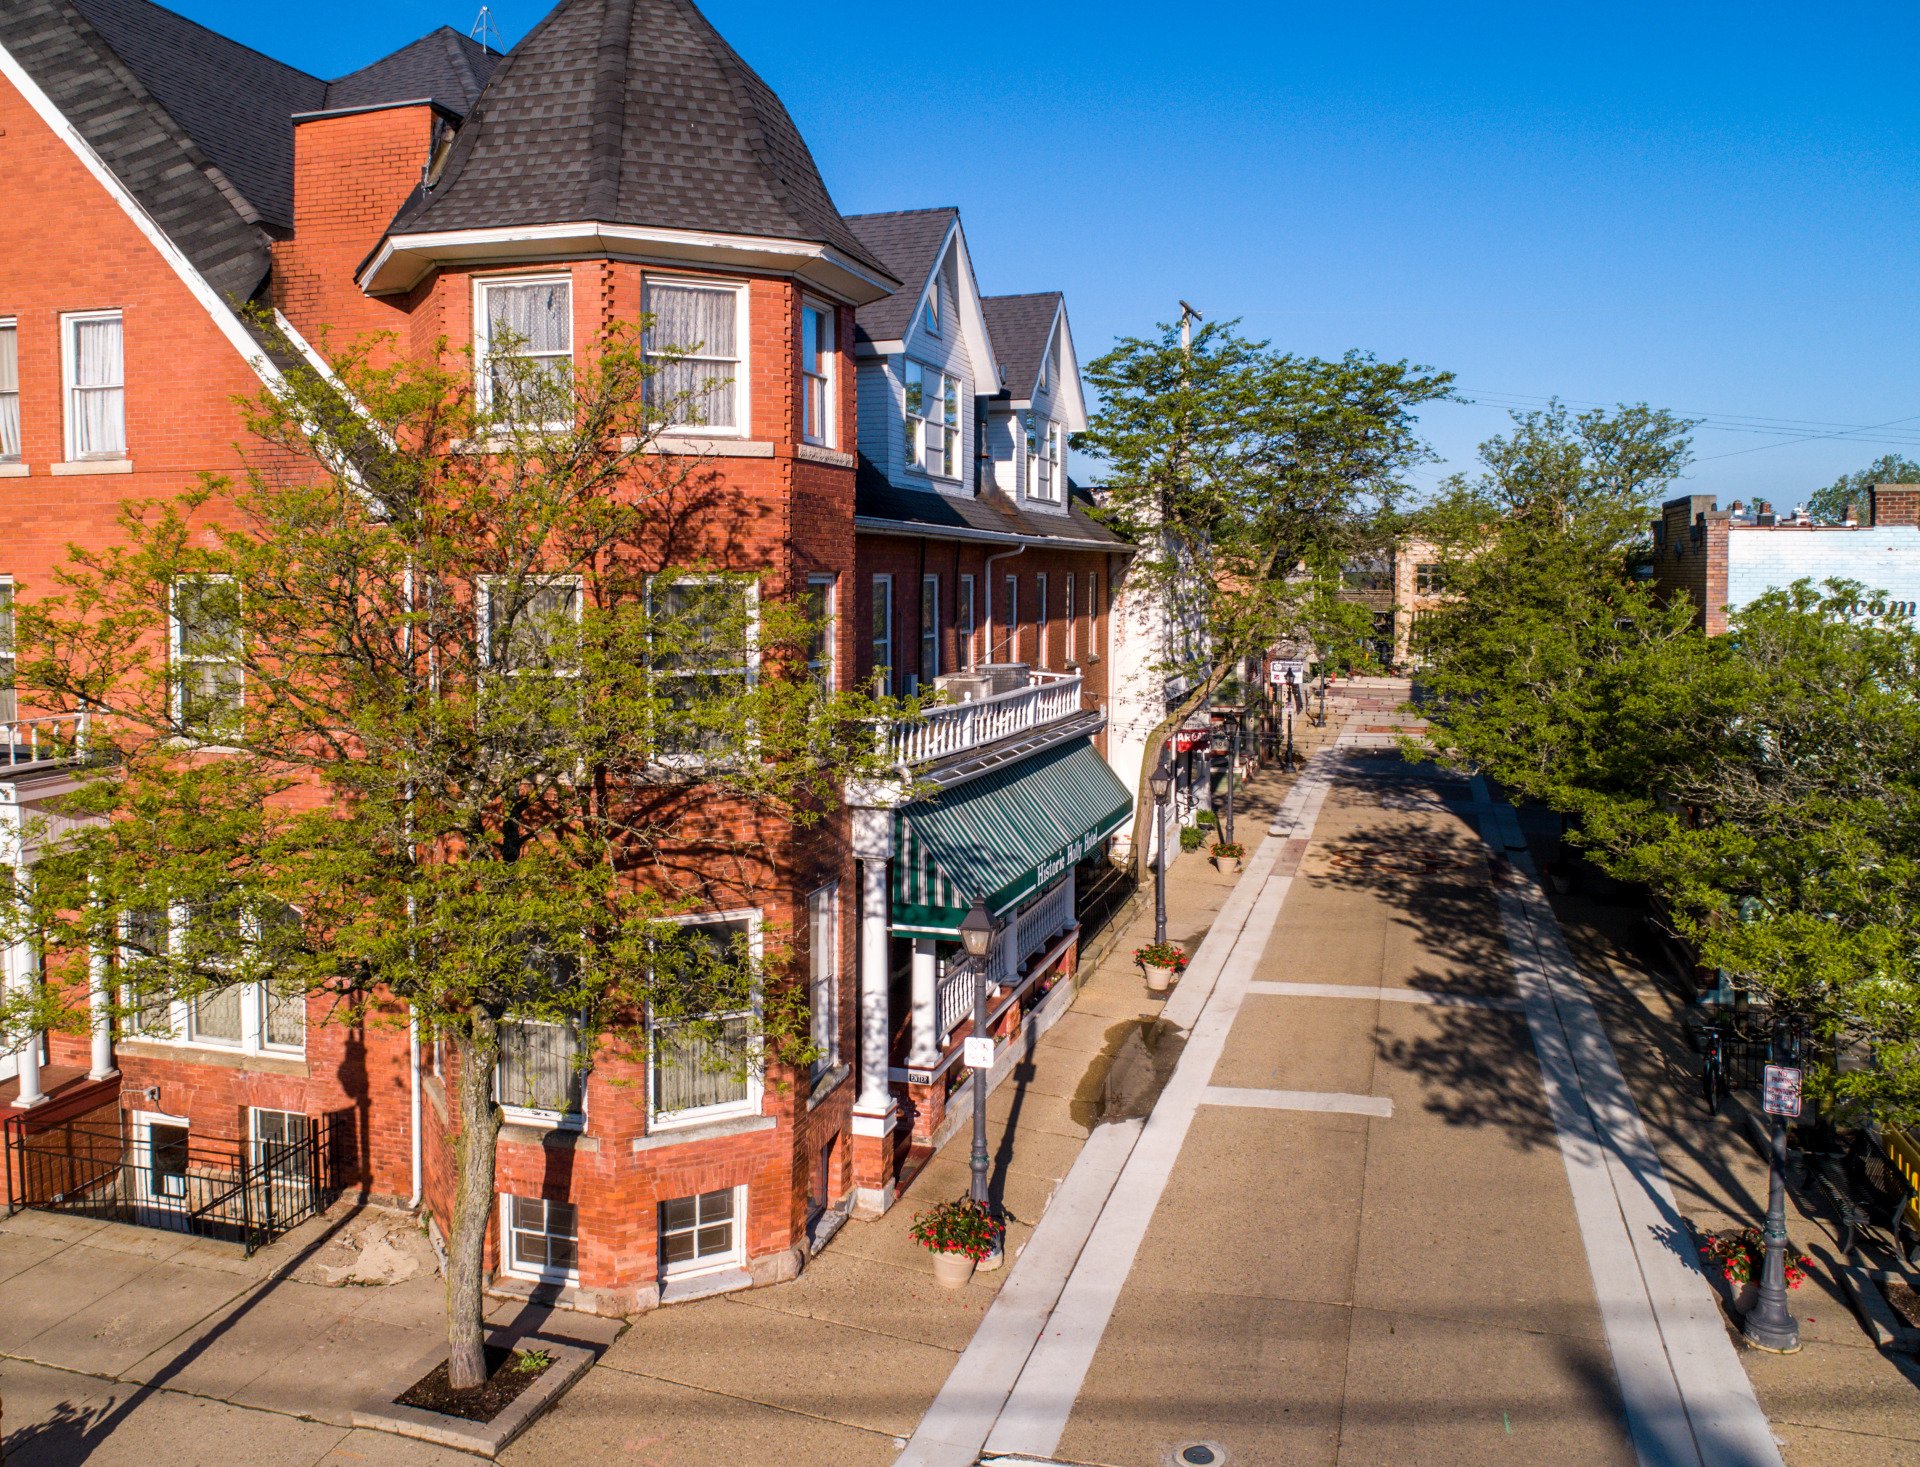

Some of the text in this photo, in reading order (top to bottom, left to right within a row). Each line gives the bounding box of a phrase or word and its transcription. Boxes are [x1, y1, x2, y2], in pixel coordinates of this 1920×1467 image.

[1037, 826, 1098, 886] Historic Holly Hotel
[911, 1074, 928, 1083] ENTER
